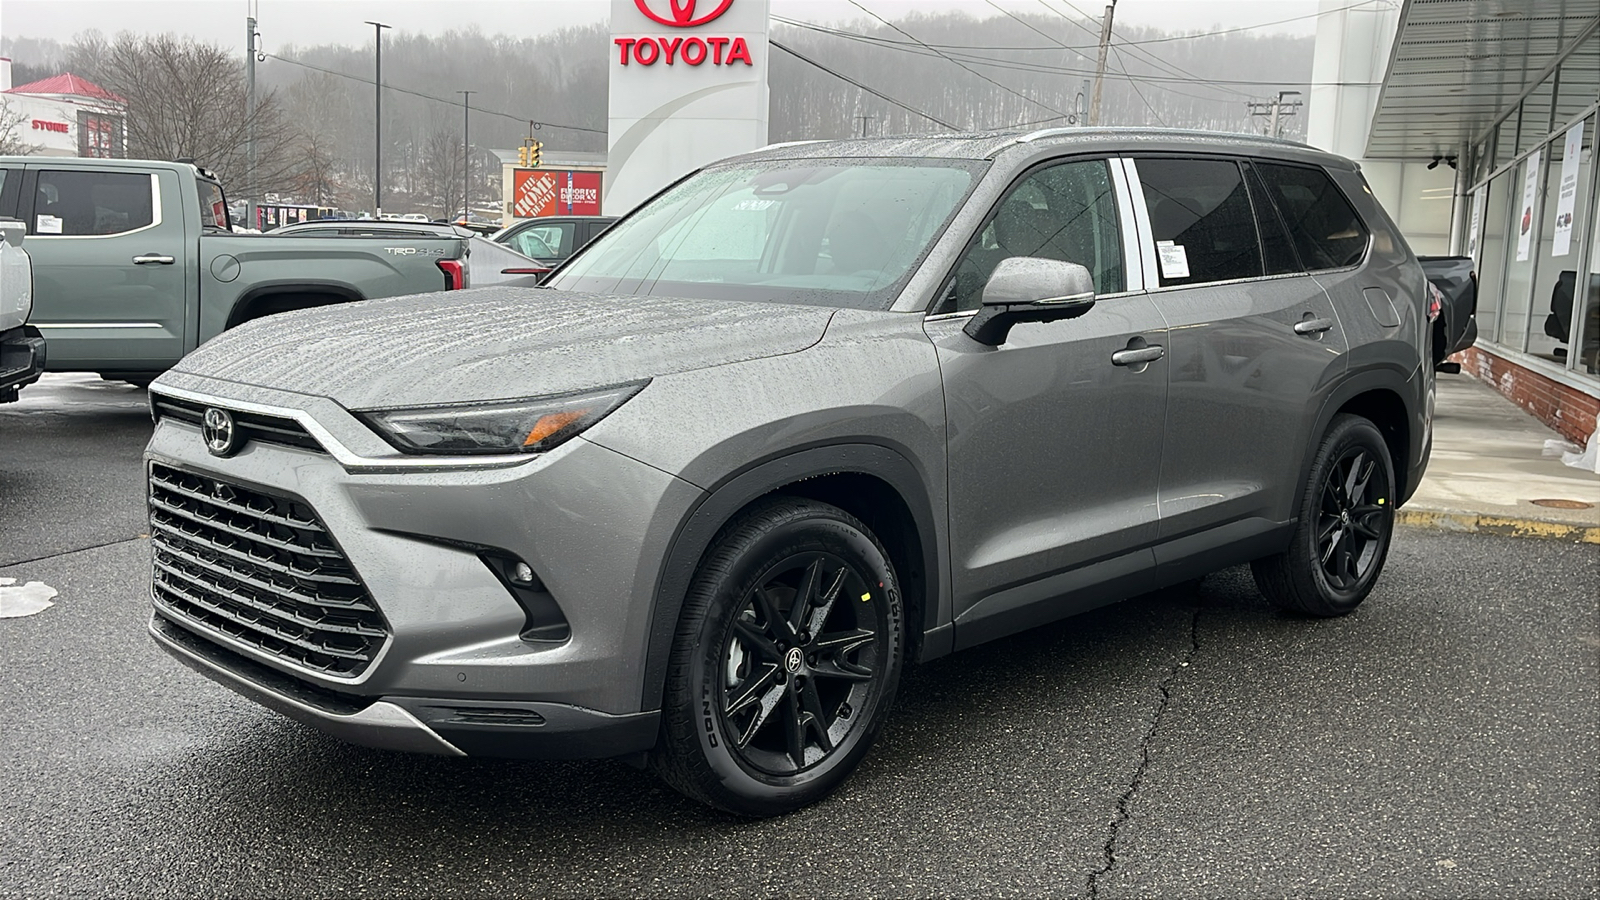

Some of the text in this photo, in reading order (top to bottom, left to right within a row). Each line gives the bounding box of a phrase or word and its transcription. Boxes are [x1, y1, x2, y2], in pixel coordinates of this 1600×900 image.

[614, 37, 753, 66] TOYOTA
[32, 119, 69, 133] STONE
[515, 172, 556, 216] HOME
[519, 174, 538, 194] THE
[530, 188, 556, 217] DEPOT
[384, 247, 416, 256] TRD
